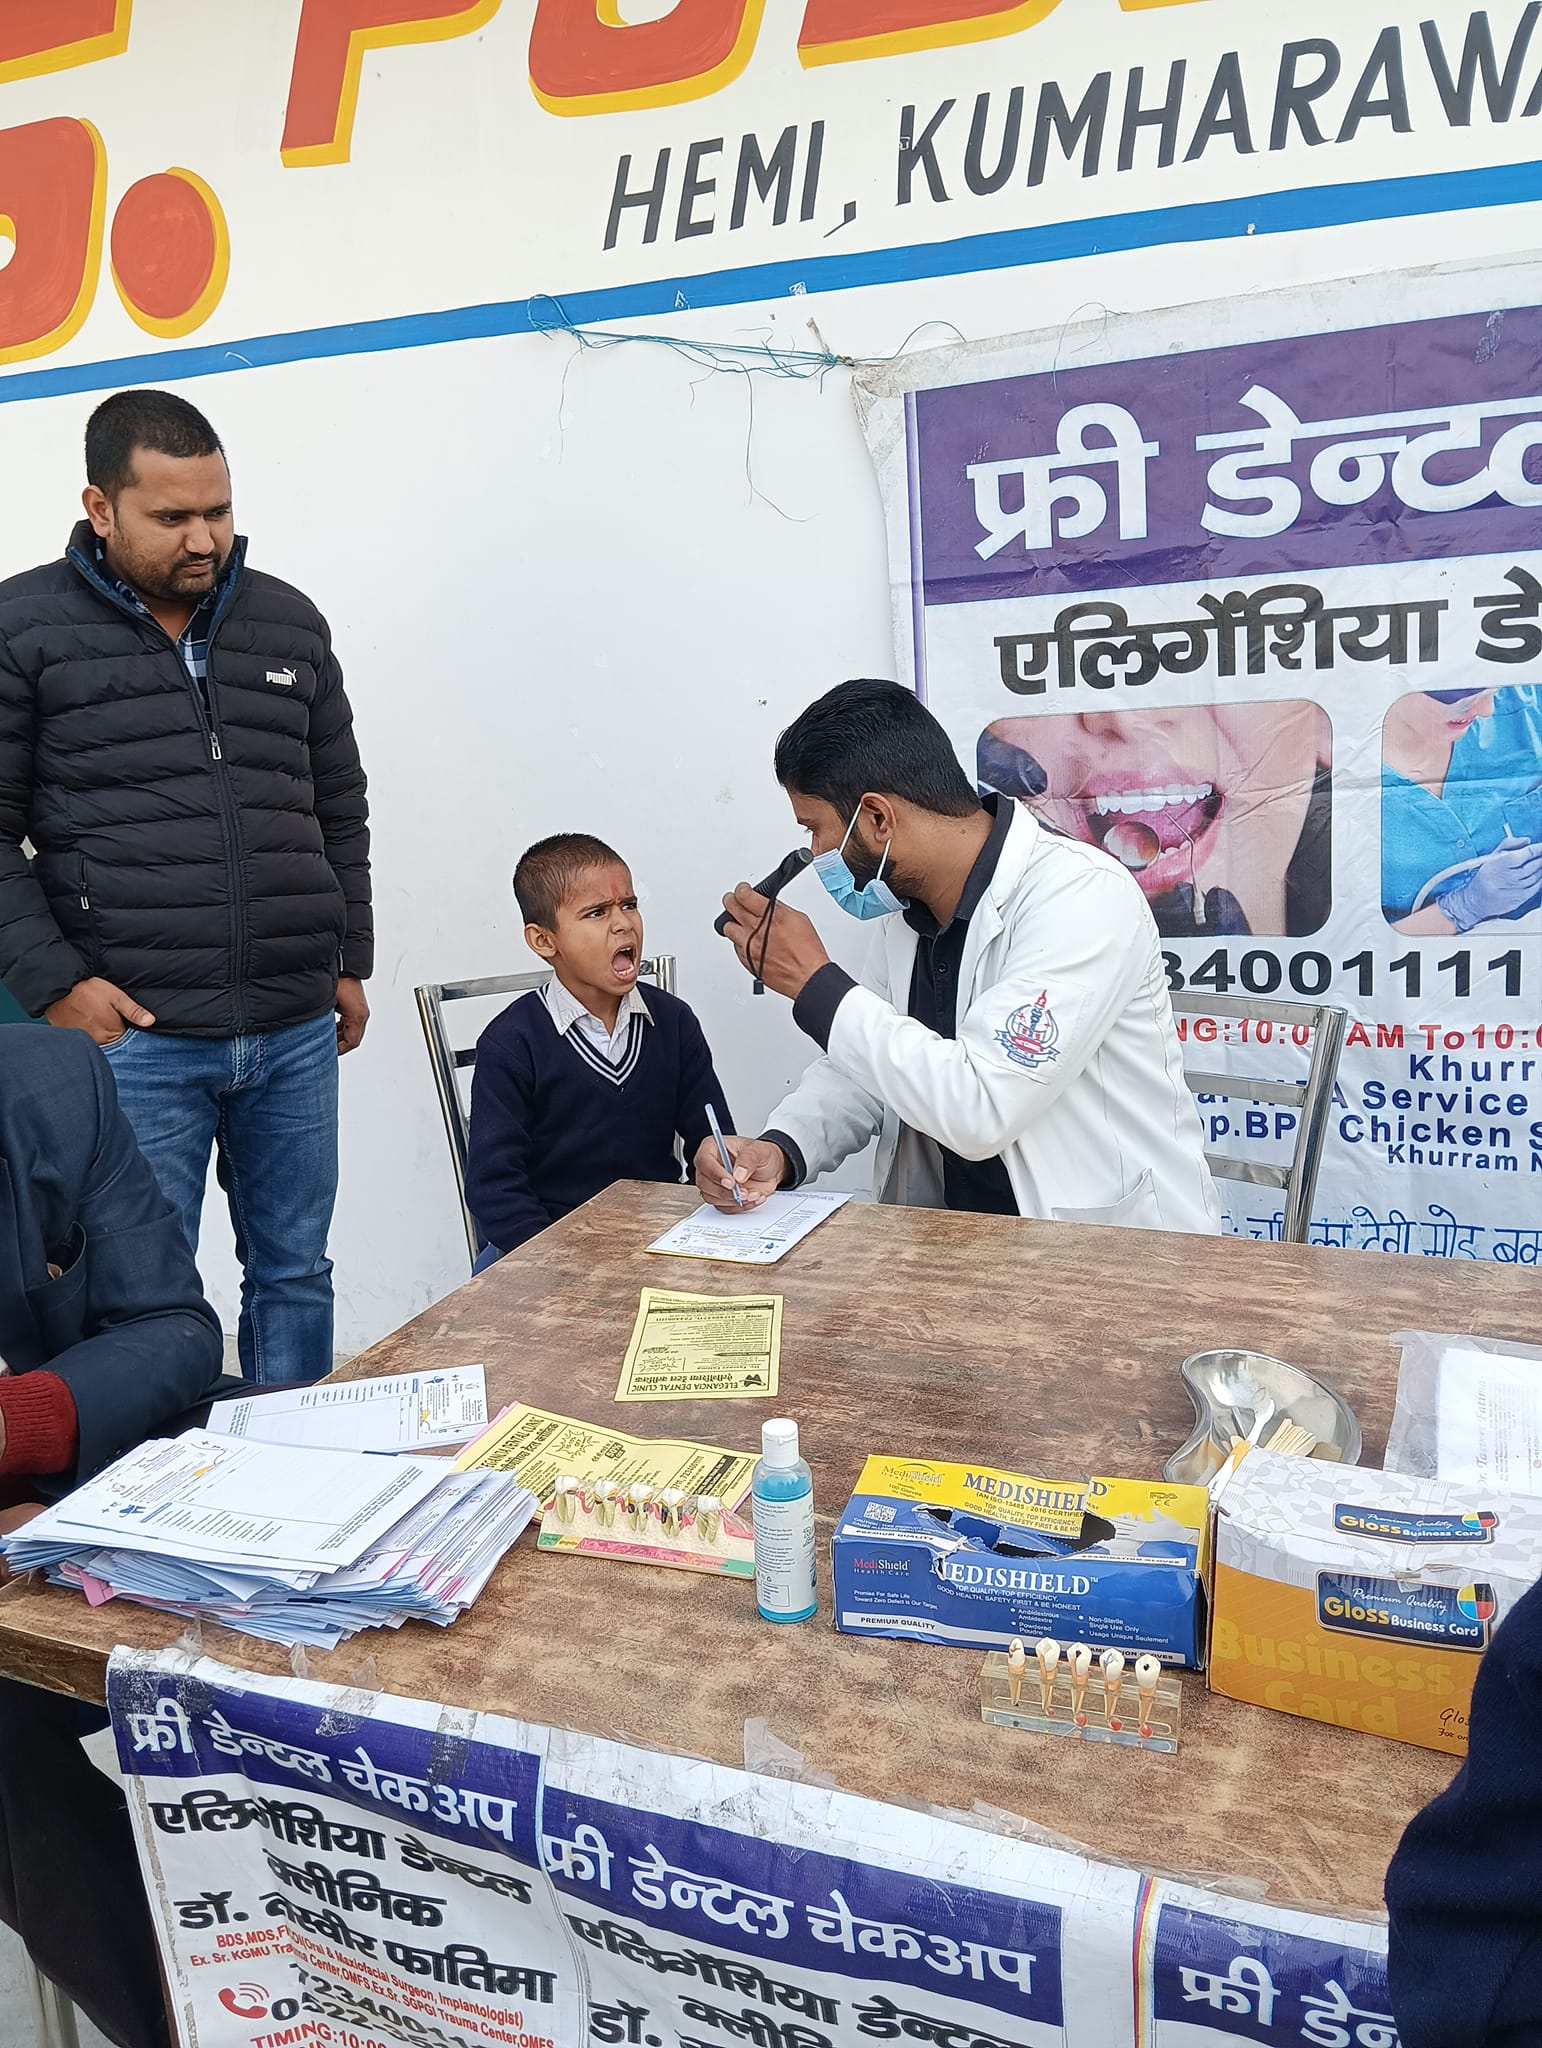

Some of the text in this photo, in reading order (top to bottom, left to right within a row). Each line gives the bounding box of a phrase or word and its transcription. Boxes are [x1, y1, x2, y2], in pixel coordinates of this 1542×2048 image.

[602, 120, 856, 251] HEMI,
[966, 402, 1160, 561] फ्री
[265, 671, 293, 686] PUMA
[1362, 1080, 1529, 1116] Service
[1338, 1114, 1511, 1148] Chicken
[1387, 1143, 1518, 1172] Khurram
[631, 1381, 738, 1393] ELEGANCIA DENTAL CLINIC
[1010, 1516, 1034, 1527] SAFETY
[1034, 1521, 1053, 1530] FIRST
[1339, 1515, 1401, 1535] Gloss
[1402, 1528, 1452, 1537] Business
[1367, 1513, 1454, 1529] Premium Quality
[853, 1557, 910, 1571] MediShield
[936, 1584, 955, 1596] GOOD
[984, 1595, 1011, 1605] SAFETY
[1012, 1598, 1033, 1607] FIRST
[1040, 1601, 1051, 1609] BE
[1051, 1602, 1082, 1611] HONEST
[1352, 1587, 1449, 1616] Premium Quality
[860, 1616, 936, 1630] PREMIUM QUALITY
[1018, 1622, 1053, 1632] Powdered
[1088, 1622, 1109, 1630] Single
[1124, 1625, 1140, 1633] Only
[1323, 1596, 1479, 1637] Gloss Business Card
[1019, 1627, 1044, 1636] Poudre
[1089, 1630, 1110, 1639] Usage
[1111, 1632, 1134, 1641] Unique
[1213, 1616, 1456, 1696] Business
[1264, 1679, 1400, 1735] Card
[1439, 1707, 1468, 1727] Glo
[125, 1697, 518, 1843] फ्री डेन्टल चेकअप
[262, 1848, 448, 1928] क्लीनिक
[542, 1824, 1038, 1995] फ्री डेन्टल चेकअप
[173, 1890, 250, 1930] डॉ.
[382, 1943, 558, 2004] फातिमा
[189, 1954, 211, 1967] Ex.
[211, 1952, 231, 1965] Sr.
[231, 1946, 271, 1961] KGMU
[402, 1994, 437, 2018] SGPGI
[437, 2008, 480, 2033] Trauma
[390, 1973, 438, 2006] Surgeon,
[438, 1991, 524, 2031] Implantologist)
[1178, 1955, 1282, 2027] फ्री
